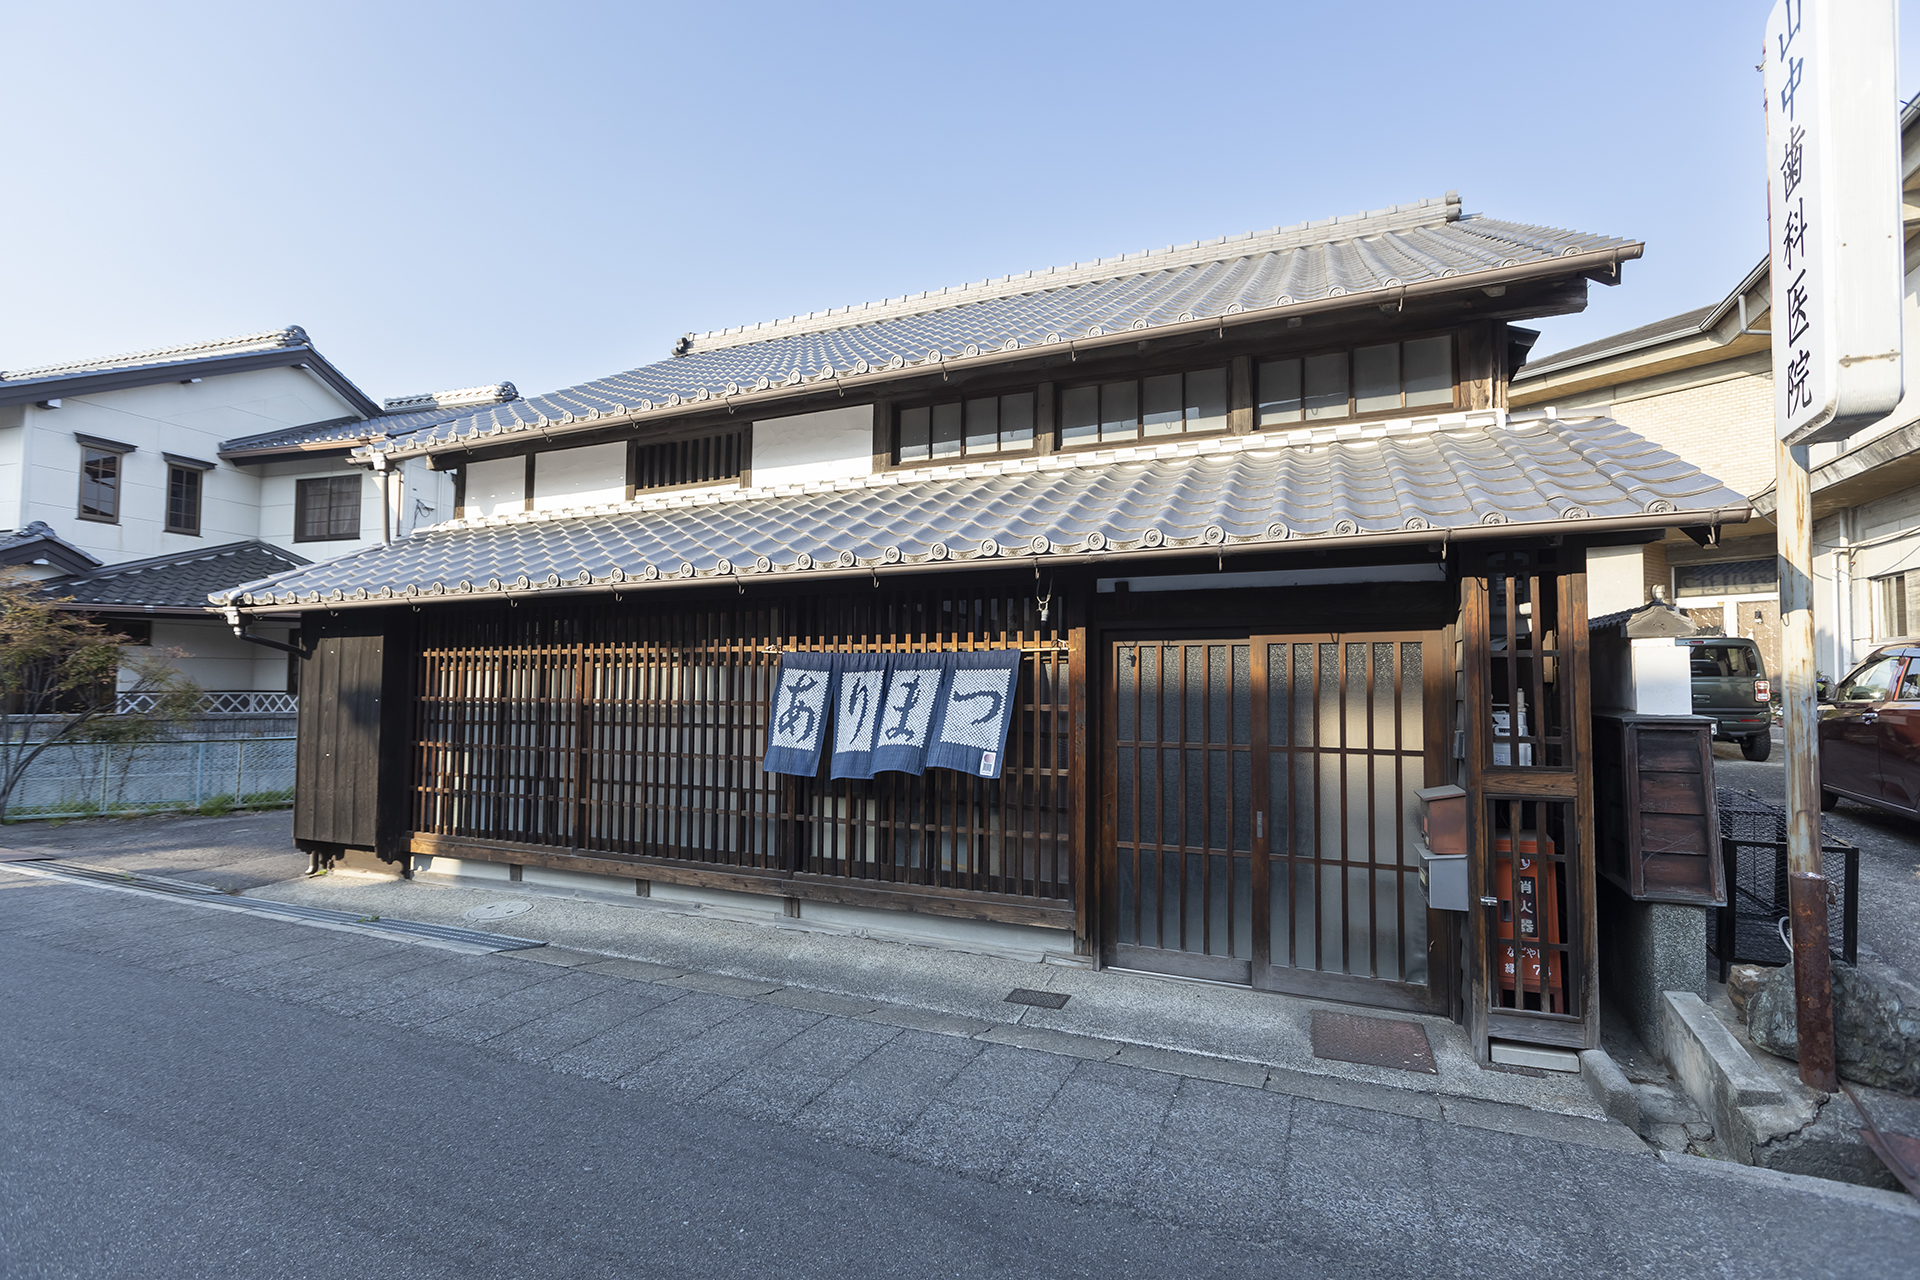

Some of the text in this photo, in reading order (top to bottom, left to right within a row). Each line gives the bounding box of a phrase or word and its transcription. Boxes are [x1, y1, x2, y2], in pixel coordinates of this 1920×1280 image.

[1778, 0, 1813, 419] 山中歯科医院
[778, 674, 1001, 744] ありまつ
[1520, 880, 1534, 933] 消火器
